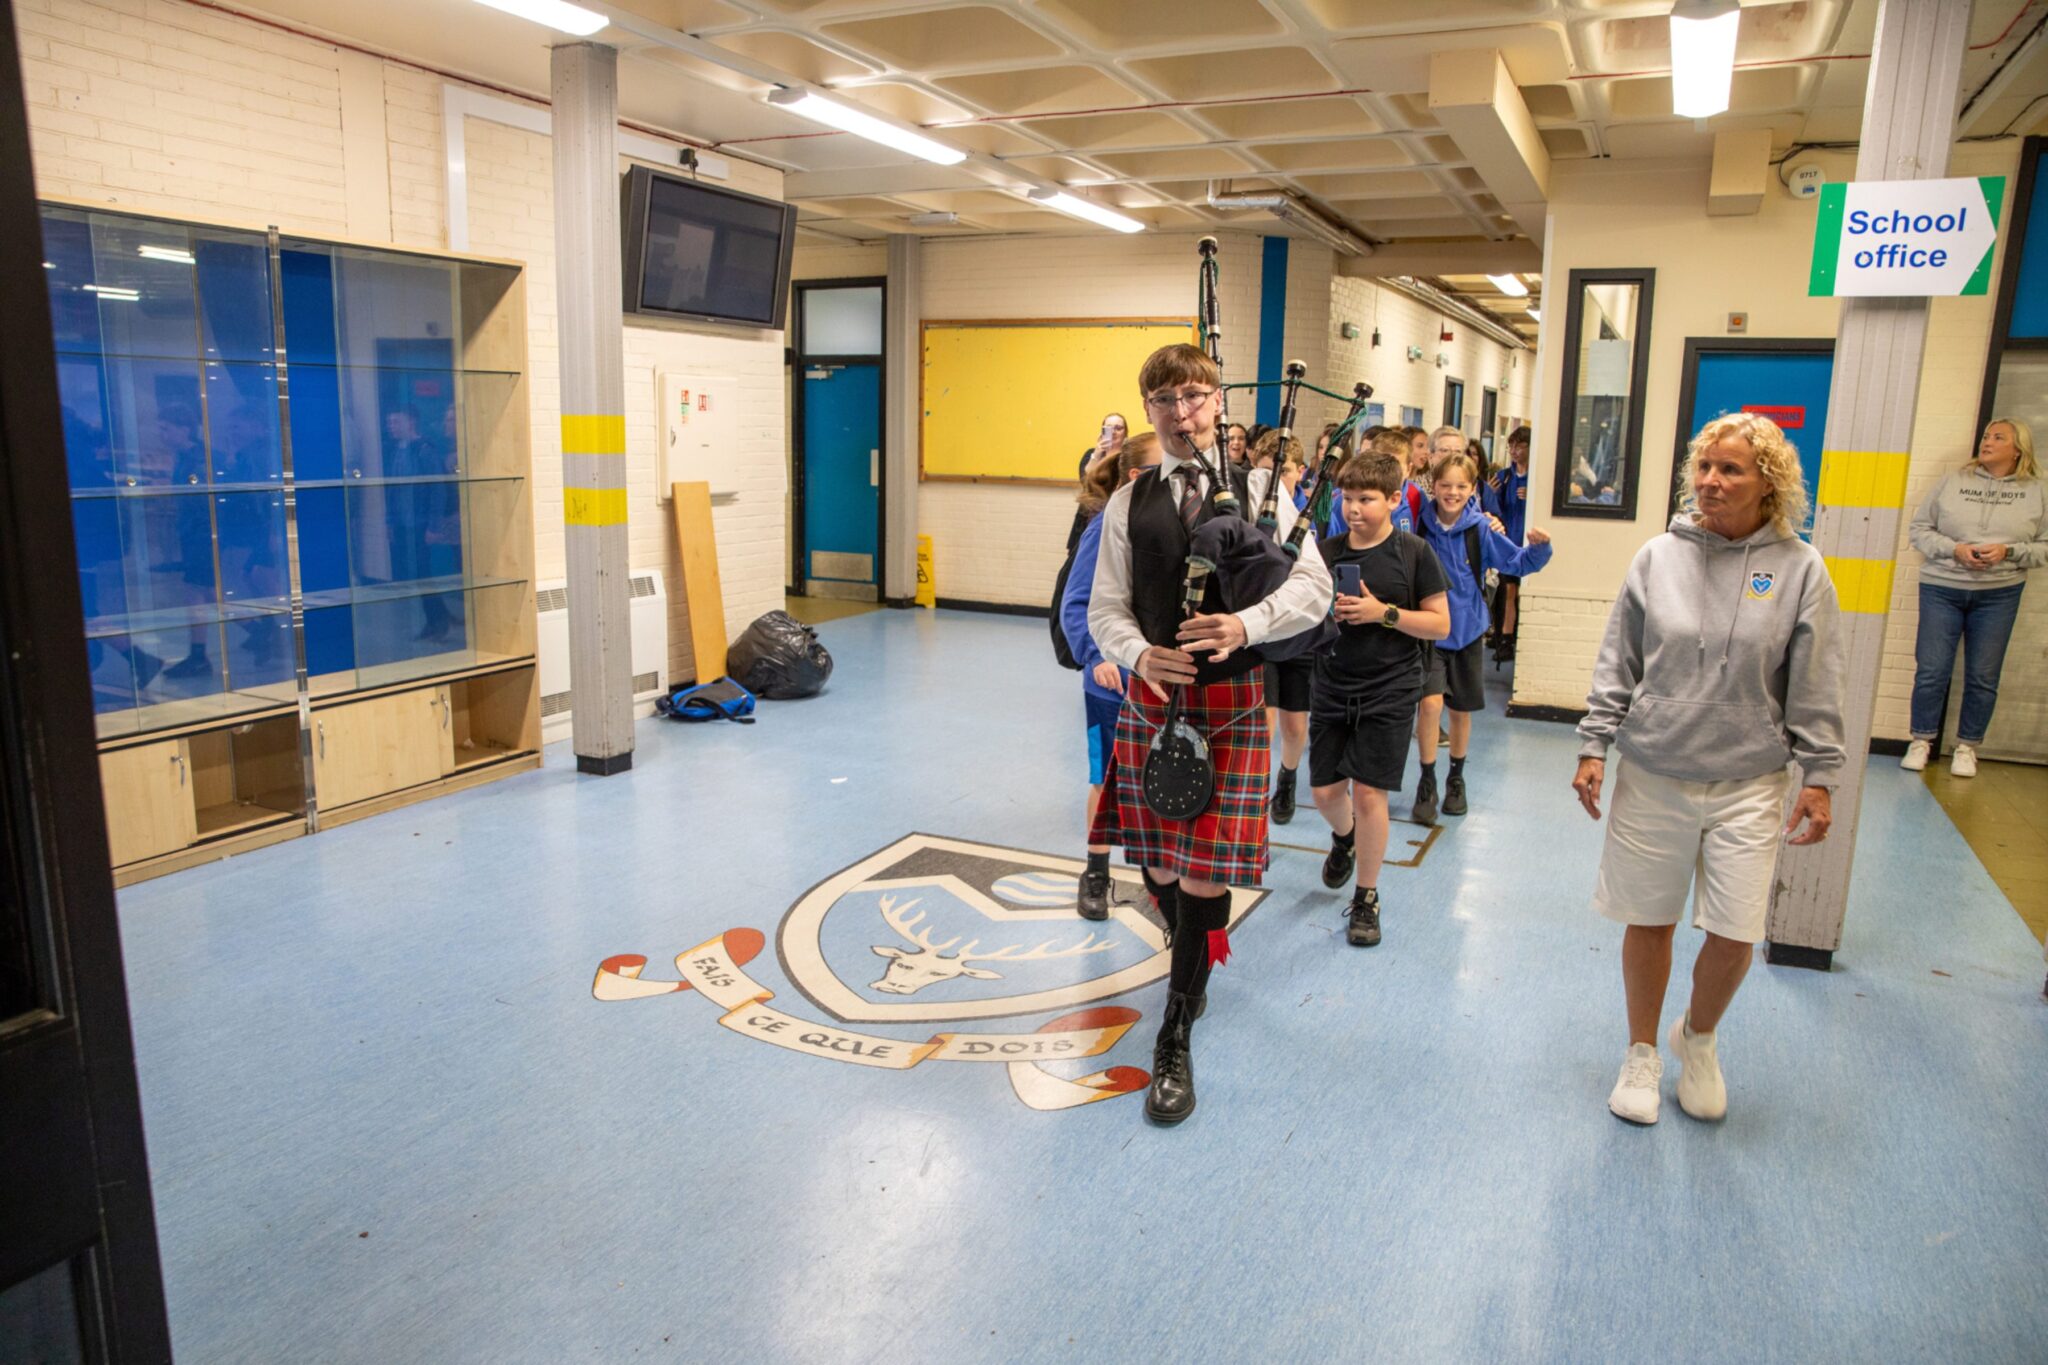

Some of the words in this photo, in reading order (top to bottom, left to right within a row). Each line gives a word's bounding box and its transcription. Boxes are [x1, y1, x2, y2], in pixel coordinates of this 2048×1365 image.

[1847, 207, 1967, 235] School
[1854, 244, 1948, 269] office
[1959, 488, 1982, 497] MUM
[1985, 490, 1998, 498] OF
[692, 956, 736, 987] FAIS
[747, 1015, 790, 1034] CE
[798, 1032, 894, 1059] QUE
[958, 1039, 1075, 1054] DOIS
